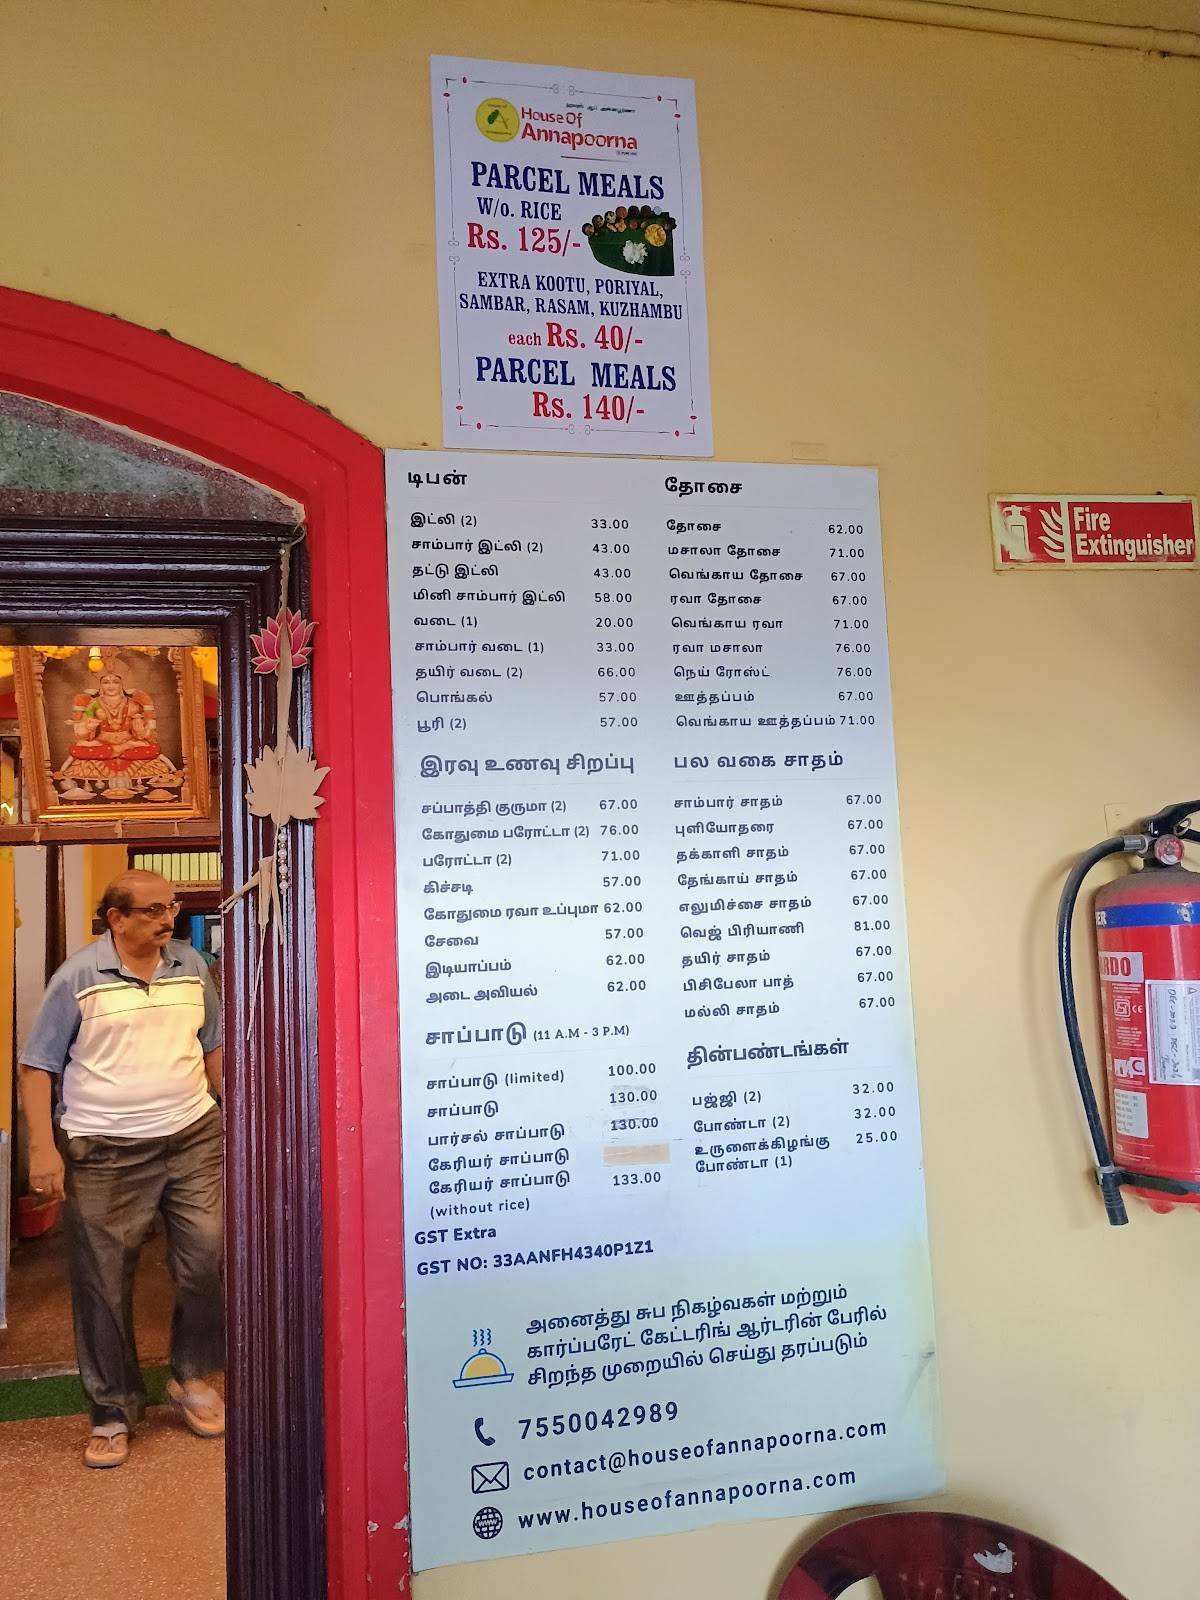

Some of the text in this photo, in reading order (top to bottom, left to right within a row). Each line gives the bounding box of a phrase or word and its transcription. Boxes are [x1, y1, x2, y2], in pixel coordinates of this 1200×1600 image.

[521, 107, 564, 124] House
[566, 112, 583, 129] Of
[521, 124, 638, 151] Annapoorna
[471, 161, 664, 200] PARCEL MEALS
[476, 197, 561, 221] W/o. RICE
[467, 222, 581, 257] Rs. 125/-
[477, 271, 663, 299] EXTRA KOOTU, PORIYAL,
[459, 293, 682, 320] SAMBAR, RASAM, KUZHAMBU
[509, 322, 643, 354] each Rs. 40/-
[476, 356, 676, 391] PARCEL MEALS
[532, 391, 644, 424] Rs. 140/-
[408, 469, 467, 488] டிபன்
[665, 476, 742, 498] தோசை
[410, 512, 629, 529] இட்லி (2) 33.00
[666, 519, 863, 535] தோசை 62.00
[1073, 506, 1111, 532] Fire
[411, 538, 630, 555] சாம்பார் இட்லி (2) 43.00
[668, 544, 864, 559] மசாலா தோசை 71.00
[1075, 533, 1195, 562] Extinguisher
[413, 588, 632, 606] மினி சாம்பார் இட்லி 58.00
[414, 616, 633, 628] வடை (1) 20.00
[671, 616, 869, 631] வெங்காய ரவா 71.00
[674, 665, 872, 681] நெய் ரோஸ்ட் 76.00
[416, 690, 637, 703] பொங்கல் 57.00
[675, 690, 873, 706] ஊத்தப்பம் 67.00
[420, 753, 634, 778] இரவு உணவு சிறப்பு
[674, 750, 843, 772] பல வகை சாதம்
[421, 799, 637, 817] சப்பாத்தி குருமா (2) 67.00
[674, 794, 882, 810] சாம்பார் சாதம் 67.00
[422, 824, 639, 843] கோதுமை பரோட்டா (2) 76.00
[675, 819, 883, 837] புளியோதரை 67.00
[676, 844, 885, 864] தக்காளி சாதம் 67.00
[423, 875, 641, 895] கிச்சடி 57.00
[679, 894, 888, 916] எலுமிச்சை சாதம் 67.00
[425, 927, 644, 947] சேவை 57.00
[680, 920, 890, 941] வெஜ் பிரியாணி 81.00
[425, 953, 645, 979] இடியாப்பம் 62.00
[426, 980, 646, 1004] அடை அவியல் 62.00
[683, 971, 893, 991] பிசிபேலா பாத் 67.00
[425, 1021, 527, 1046] சாப்பாடு
[533, 1030, 550, 1042] (11
[555, 1028, 580, 1039] A.M
[592, 1027, 599, 1037] 3
[603, 1025, 629, 1036] P.M)
[687, 1037, 849, 1070] தின்பண்டங்கள்
[426, 1063, 656, 1090] சாப்பாடு (limited) 100.00
[692, 1081, 894, 1109] பஜ்ஜி (2) 32.00
[693, 1106, 896, 1133] போண்டா (2) 32.00
[428, 1117, 659, 1147] பார்சல் சாப்பாடு 130.00
[695, 1130, 897, 1158] உருளைக்கிழங்கு 25.00
[696, 1155, 792, 1173] போண்டா (1)
[429, 1170, 661, 1195] கேரியர் சாப்பாடு 133.00
[430, 1198, 530, 1220] (without rice)
[414, 1227, 496, 1245] GST Extra
[417, 1240, 654, 1276] GST NO: 33AANFH4340P1Z1
[526, 1308, 631, 1335] அனைத்து
[636, 1306, 665, 1320] சுப
[781, 1283, 847, 1309] மற்றும்
[526, 1305, 886, 1360] கார்ப்பரேட் கேட்டரிங் ஆர்டரின் பேரில்
[528, 1332, 867, 1389] சிறந்த முறையில் செய்து தரப்படும்
[518, 1401, 677, 1440] 7550042989
[522, 1417, 888, 1482] contact@houseofannapoorna.com
[517, 1468, 857, 1530] www.houseofannapoorna.com
